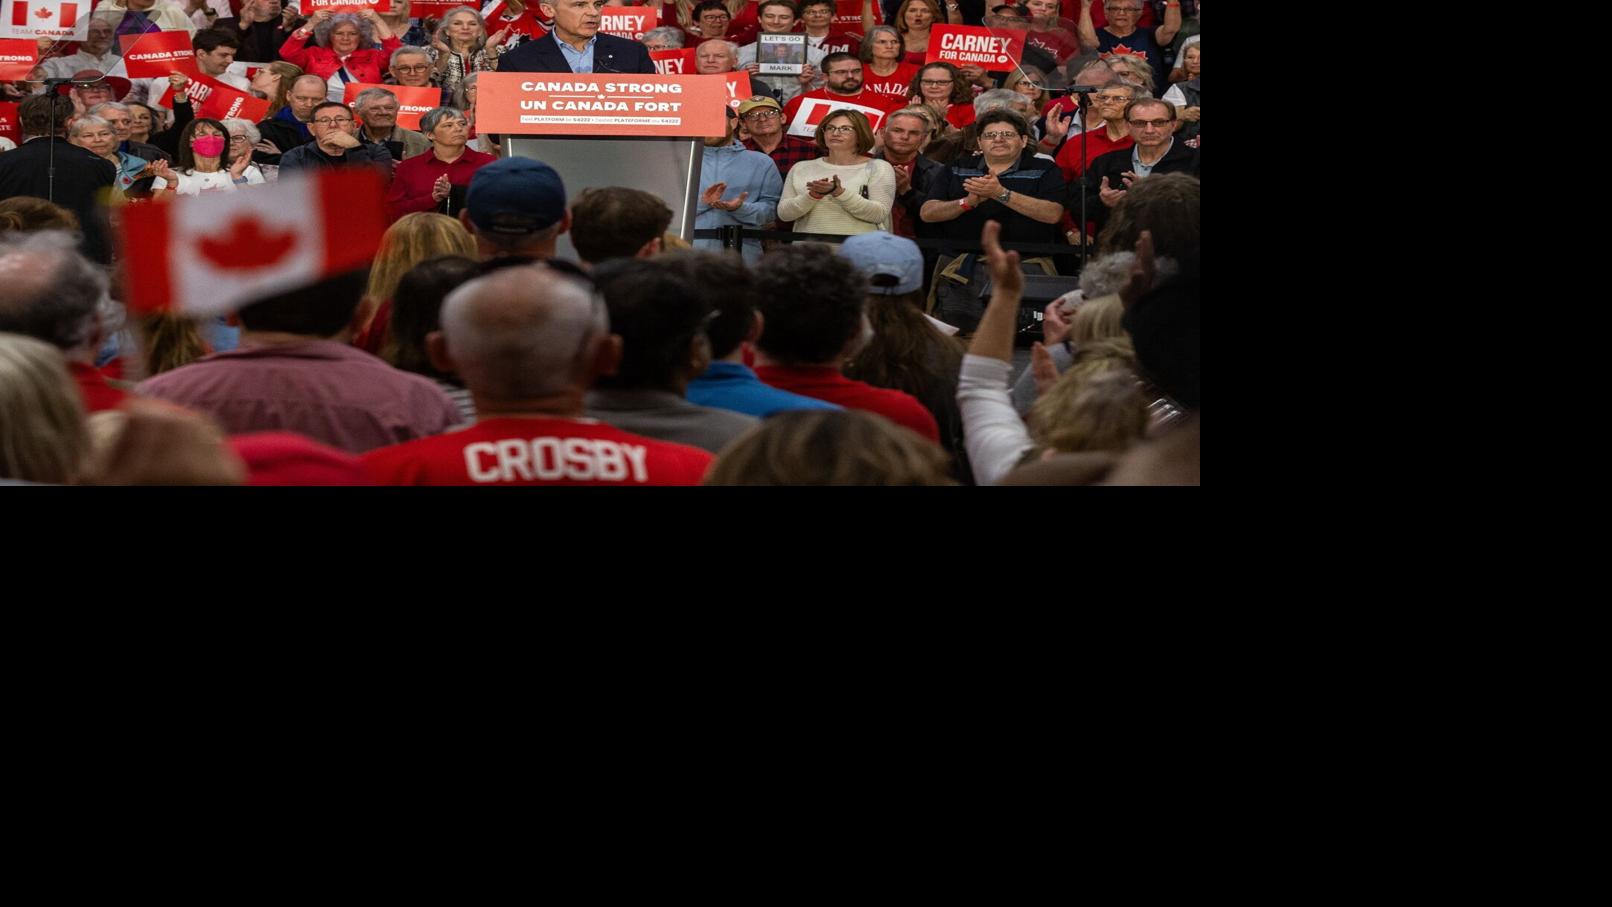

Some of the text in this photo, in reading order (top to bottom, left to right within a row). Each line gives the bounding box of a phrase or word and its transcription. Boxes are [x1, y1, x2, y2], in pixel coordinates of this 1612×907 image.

[598, 14, 645, 31] RNEY
[941, 33, 1012, 54] CARNEY
[129, 51, 172, 60] CANADA
[939, 50, 995, 63] FOR CANADA
[521, 81, 682, 93] CANADA STRONG
[520, 100, 682, 112] UN CANADA FORT
[464, 436, 648, 483] CROSBY
